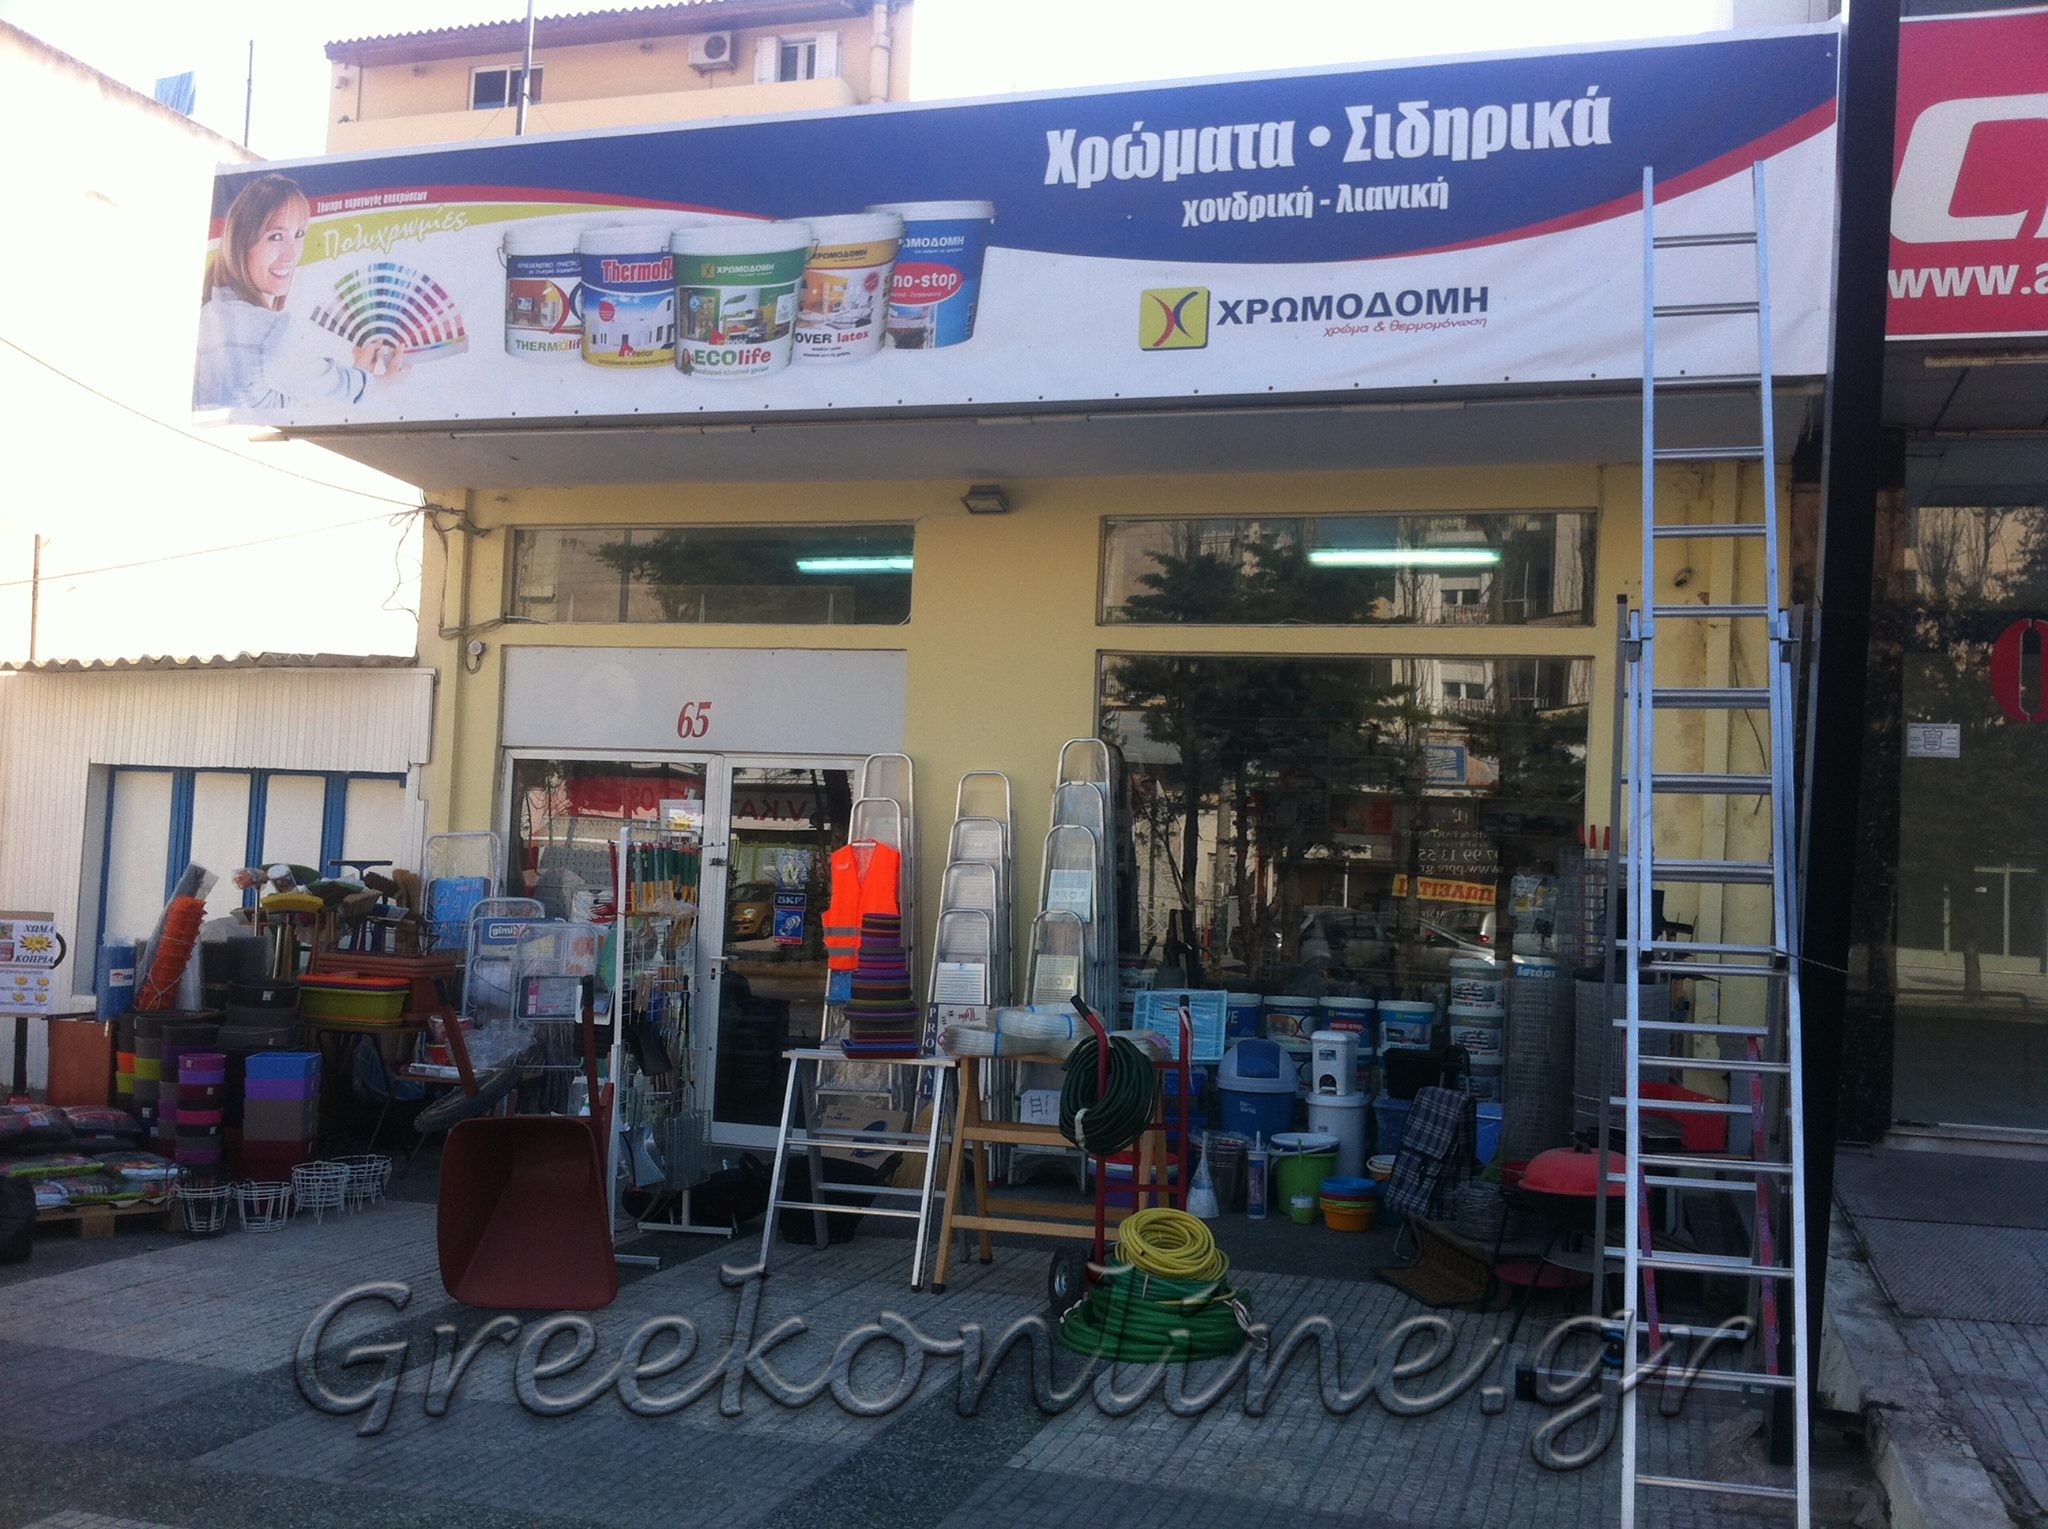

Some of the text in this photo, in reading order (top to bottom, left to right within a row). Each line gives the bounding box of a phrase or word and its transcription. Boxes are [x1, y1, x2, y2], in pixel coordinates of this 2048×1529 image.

[1044, 85, 1613, 189] Χρώματα Σιδηρικά
[1890, 92, 2048, 244] C
[1181, 185, 1314, 227] χονδρική
[1335, 176, 1450, 214] λιανική
[1216, 285, 1489, 326] ΧΡΩΜΟΔΟΜΗ
[836, 329, 870, 344] latex
[1322, 316, 1488, 338] χρώμα & θερμομόνωση
[676, 701, 713, 739] 65
[776, 896, 805, 904] SKF
[24, 924, 54, 934] ΧΩΜΑ
[491, 926, 513, 936] gimi
[14, 954, 55, 964] ΚΟΠΡΙΑ
[923, 1007, 938, 1096] PROAL
